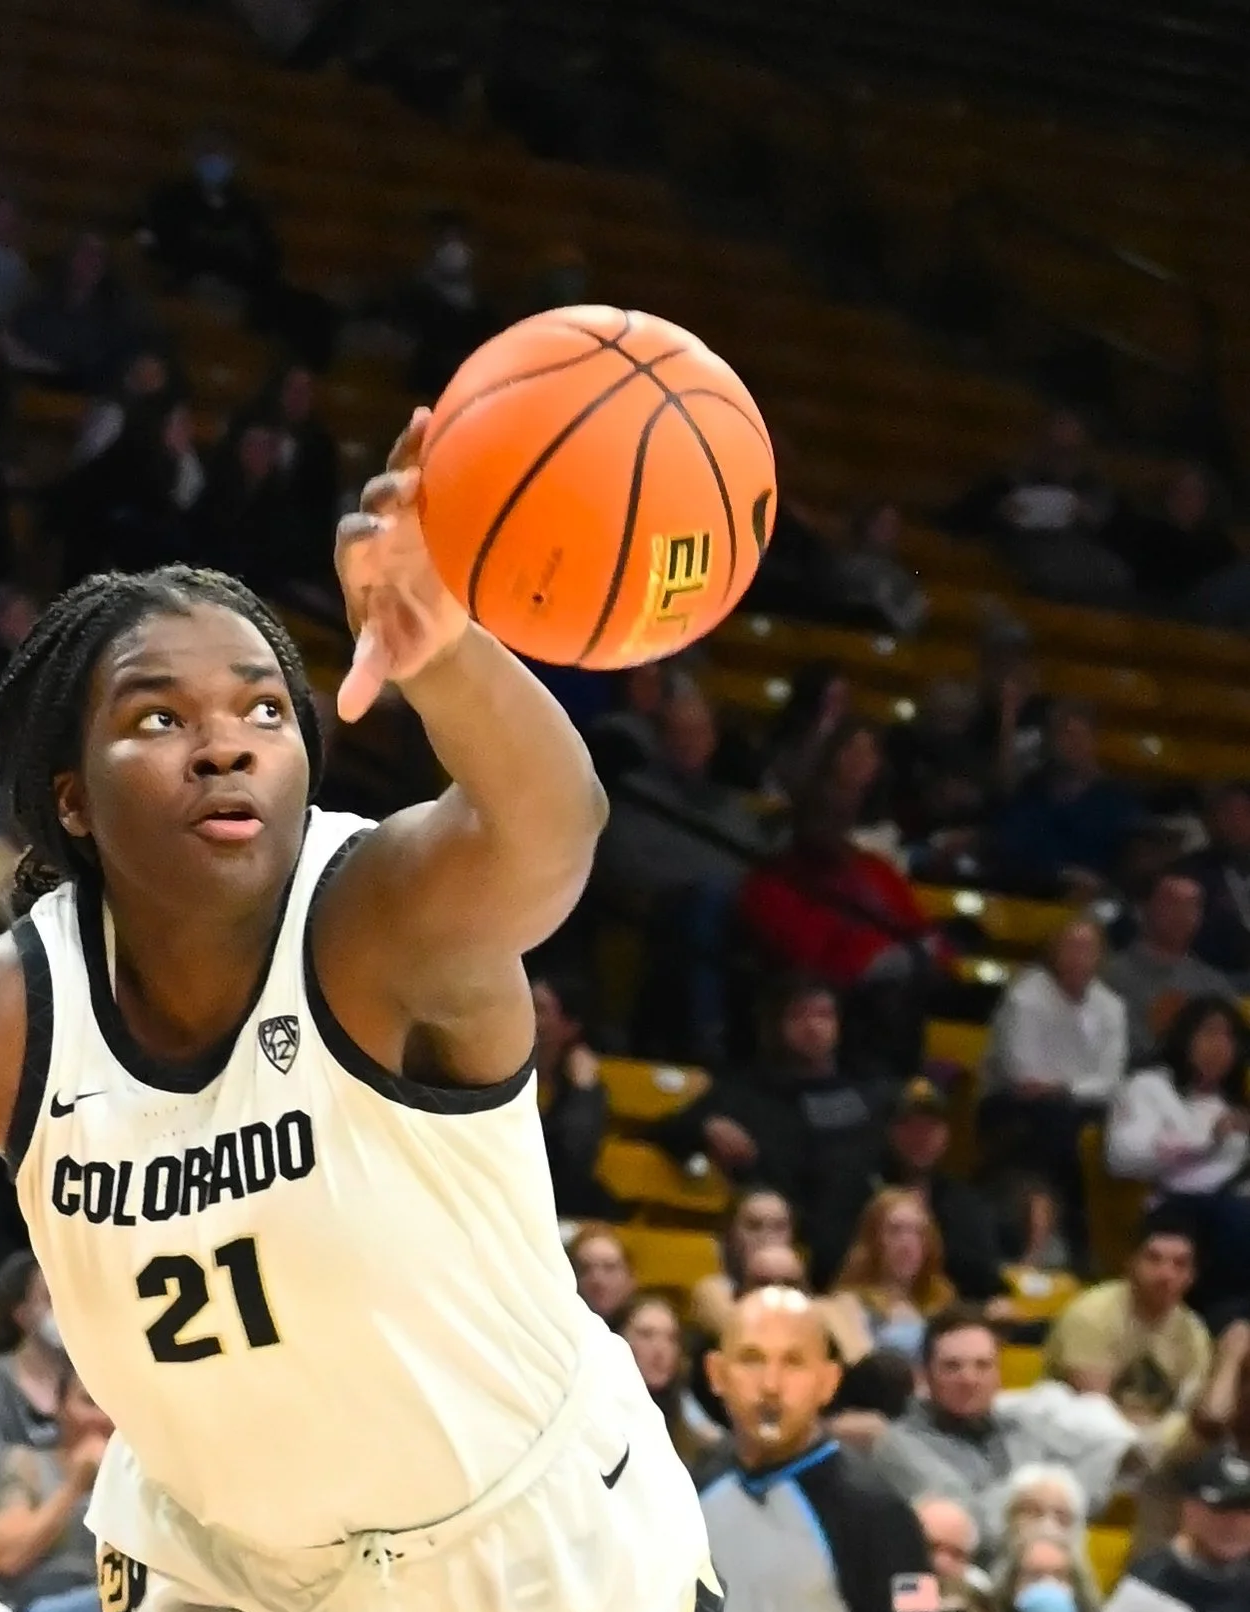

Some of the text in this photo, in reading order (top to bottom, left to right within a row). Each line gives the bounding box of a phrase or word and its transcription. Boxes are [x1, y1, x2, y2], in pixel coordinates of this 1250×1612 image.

[268, 1040, 293, 1061] 12
[52, 1109, 316, 1227] COLORADO
[135, 1236, 281, 1363] 21
